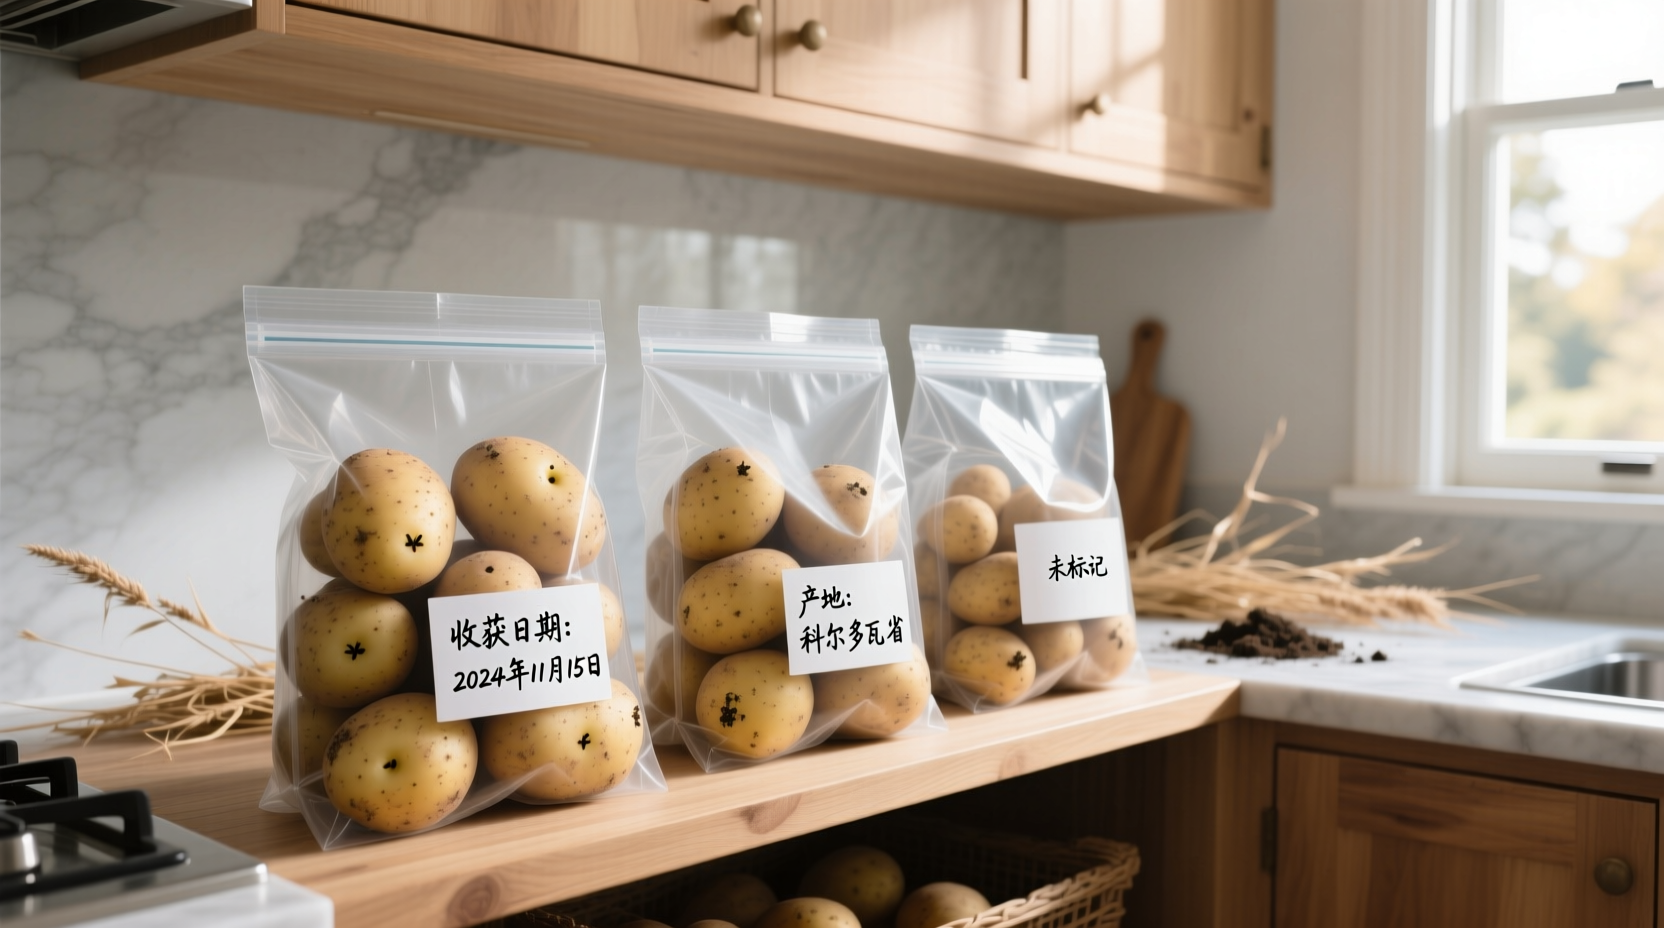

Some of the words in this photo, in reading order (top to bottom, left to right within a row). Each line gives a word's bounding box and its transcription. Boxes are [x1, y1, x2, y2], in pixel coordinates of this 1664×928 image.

[1048, 554, 1108, 582] 未标记
[799, 585, 852, 619] 产地:
[450, 611, 571, 651] 收获日期:
[799, 615, 903, 654] 科尔多瓦省
[453, 653, 601, 692] 2024年11月15日
